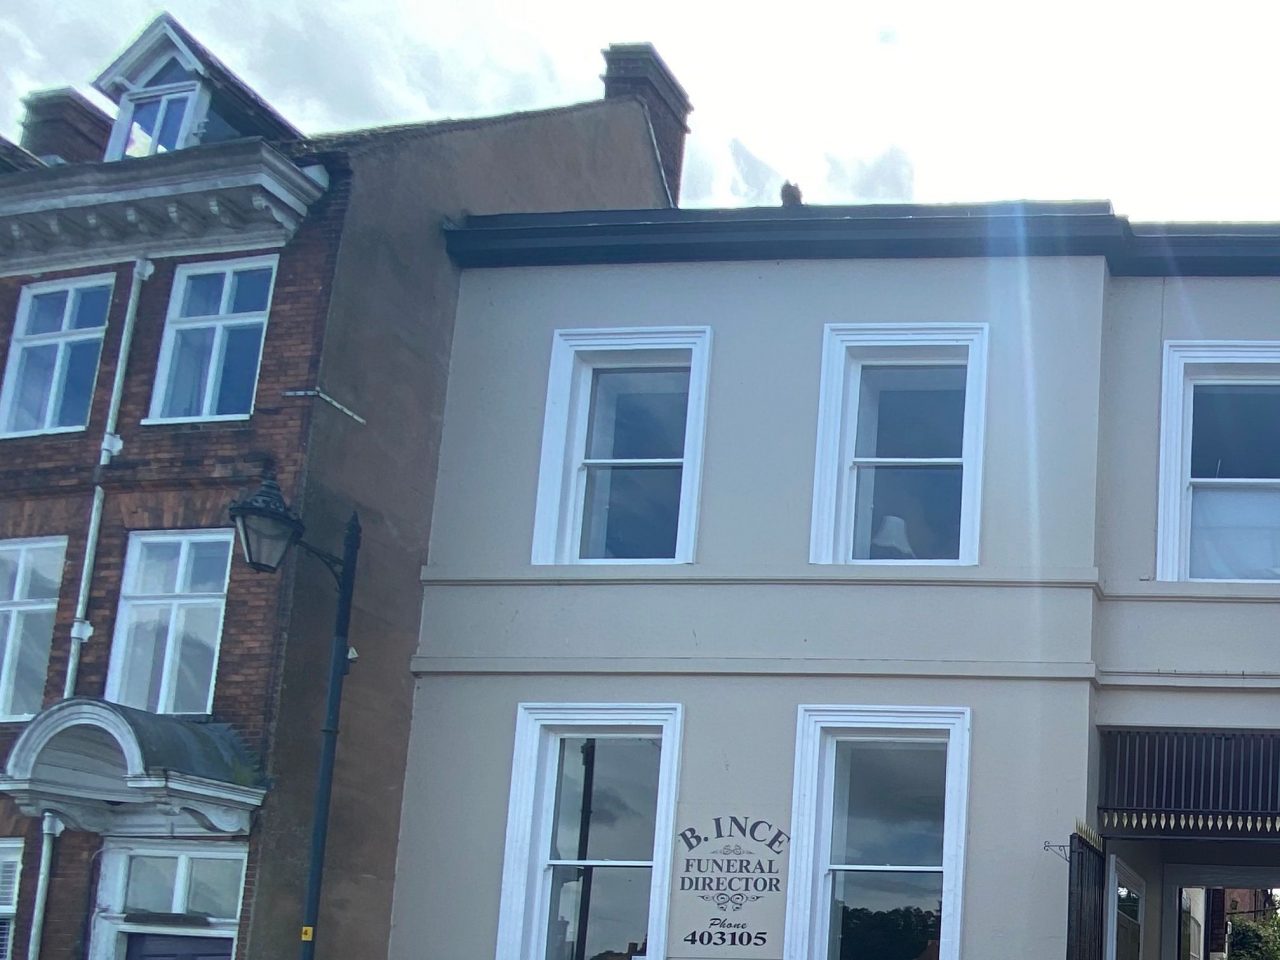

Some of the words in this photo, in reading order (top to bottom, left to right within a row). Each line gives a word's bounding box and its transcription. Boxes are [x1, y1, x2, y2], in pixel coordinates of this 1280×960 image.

[678, 827, 709, 852] B.
[712, 815, 791, 855] INCE
[685, 859, 779, 874] FUNERAL
[680, 877, 781, 892] DIRECTOR
[709, 918, 747, 929] Phone
[684, 931, 767, 946] 403105
